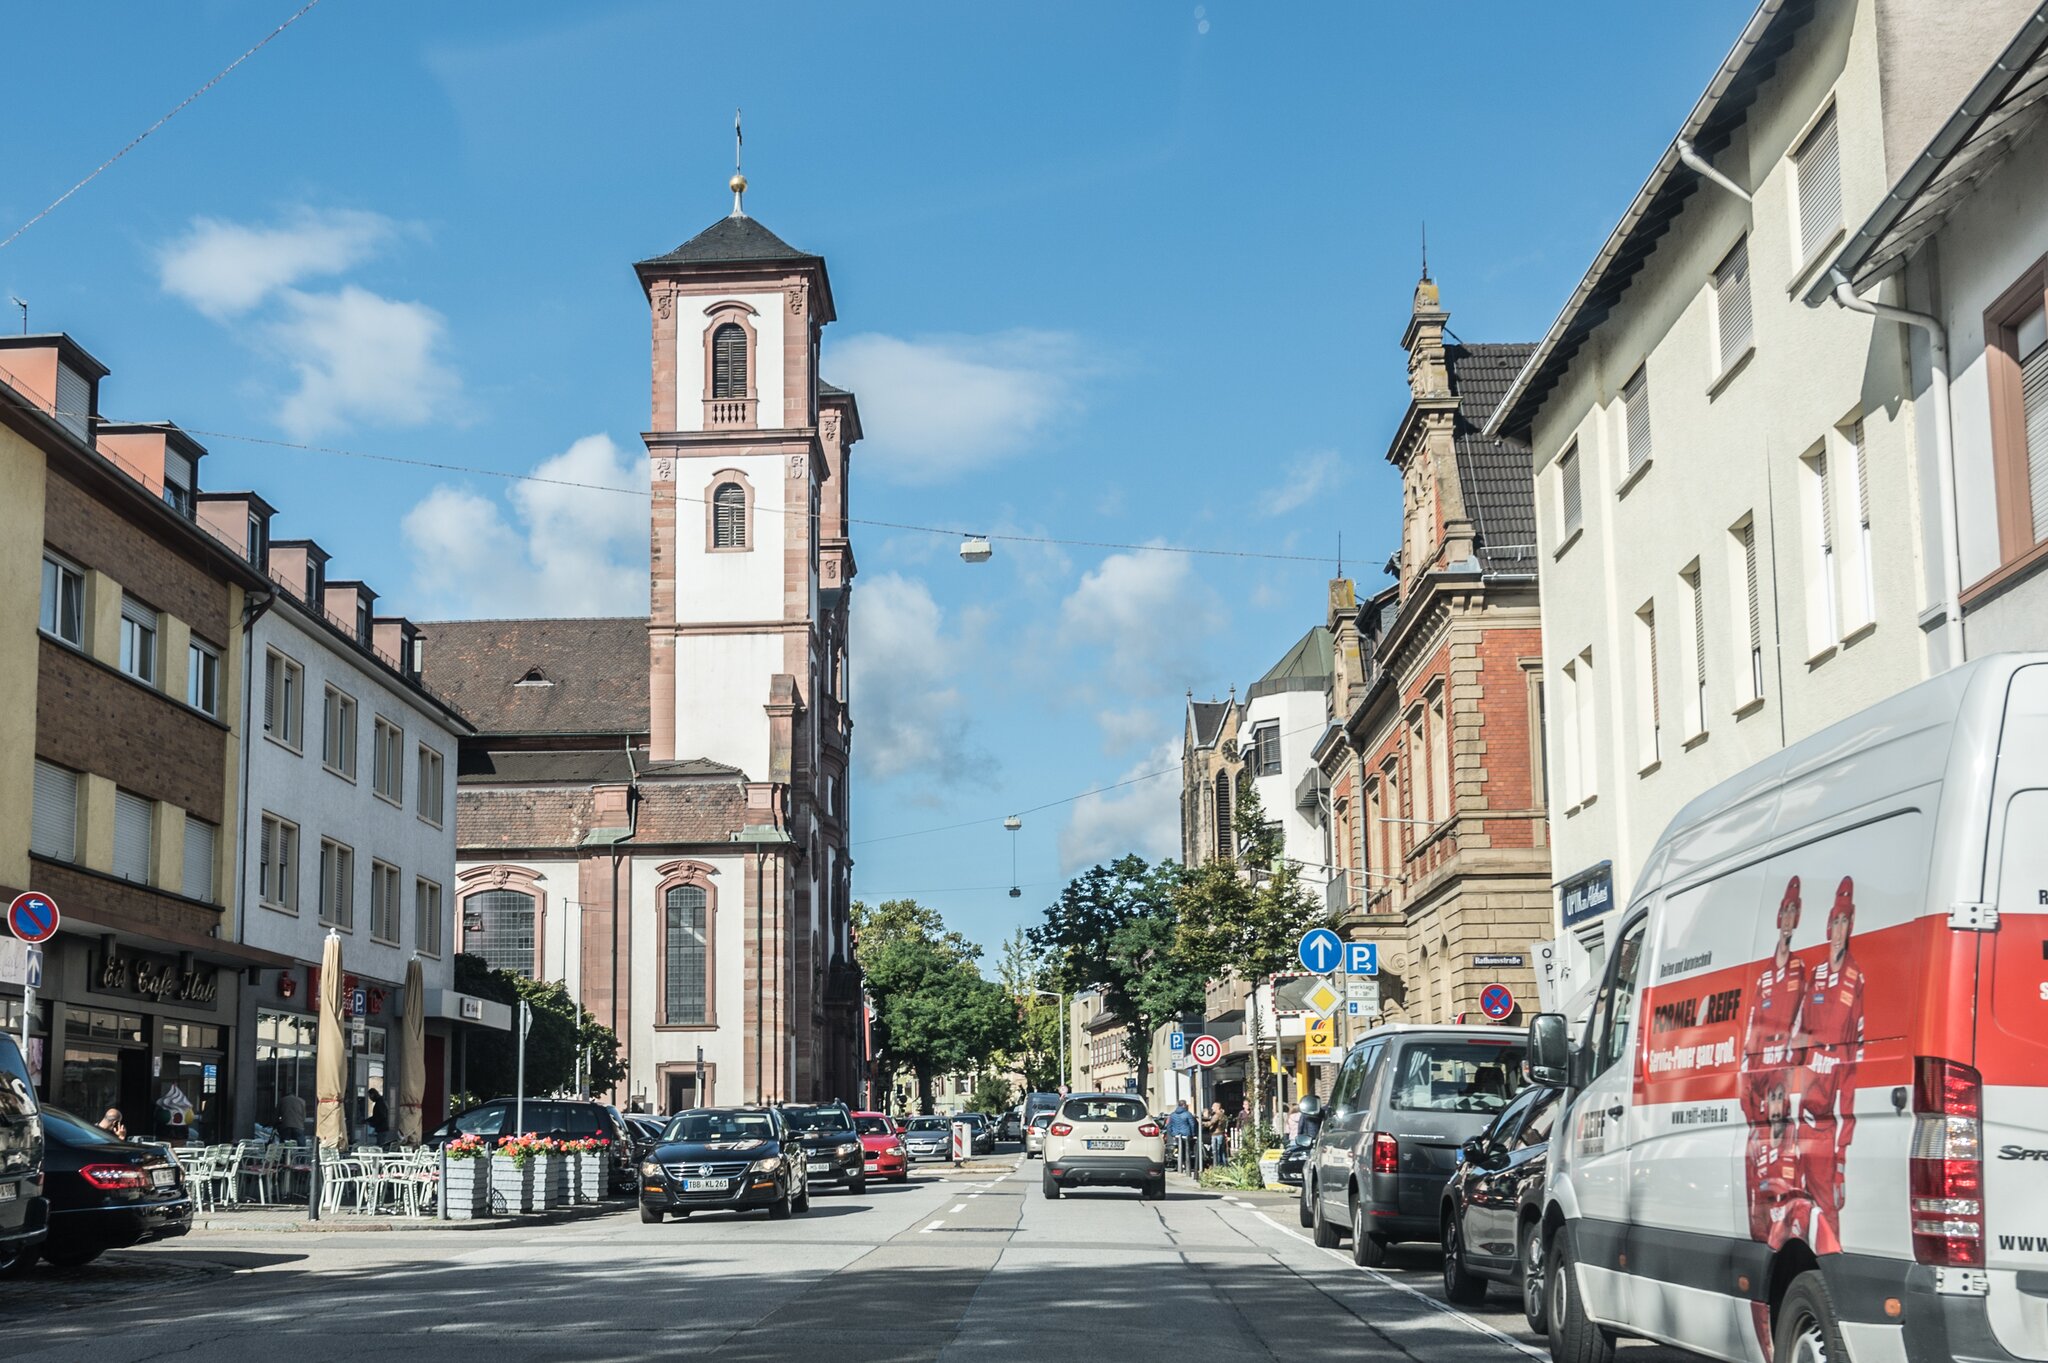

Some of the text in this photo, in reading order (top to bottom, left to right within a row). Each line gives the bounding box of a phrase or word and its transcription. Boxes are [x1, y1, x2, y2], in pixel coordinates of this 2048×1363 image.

[1352, 946, 1370, 971] P
[1474, 956, 1521, 965] Rathausstraße
[1541, 947, 1556, 1013] OPTI
[1653, 988, 1742, 1035] FORMEL REIFF
[1172, 1034, 1181, 1049] P
[1197, 1043, 1214, 1057] 30
[1648, 1045, 1697, 1073] Service-Power
[1696, 1044, 1715, 1070] ganz
[689, 1179, 727, 1189] TBB KL 261
